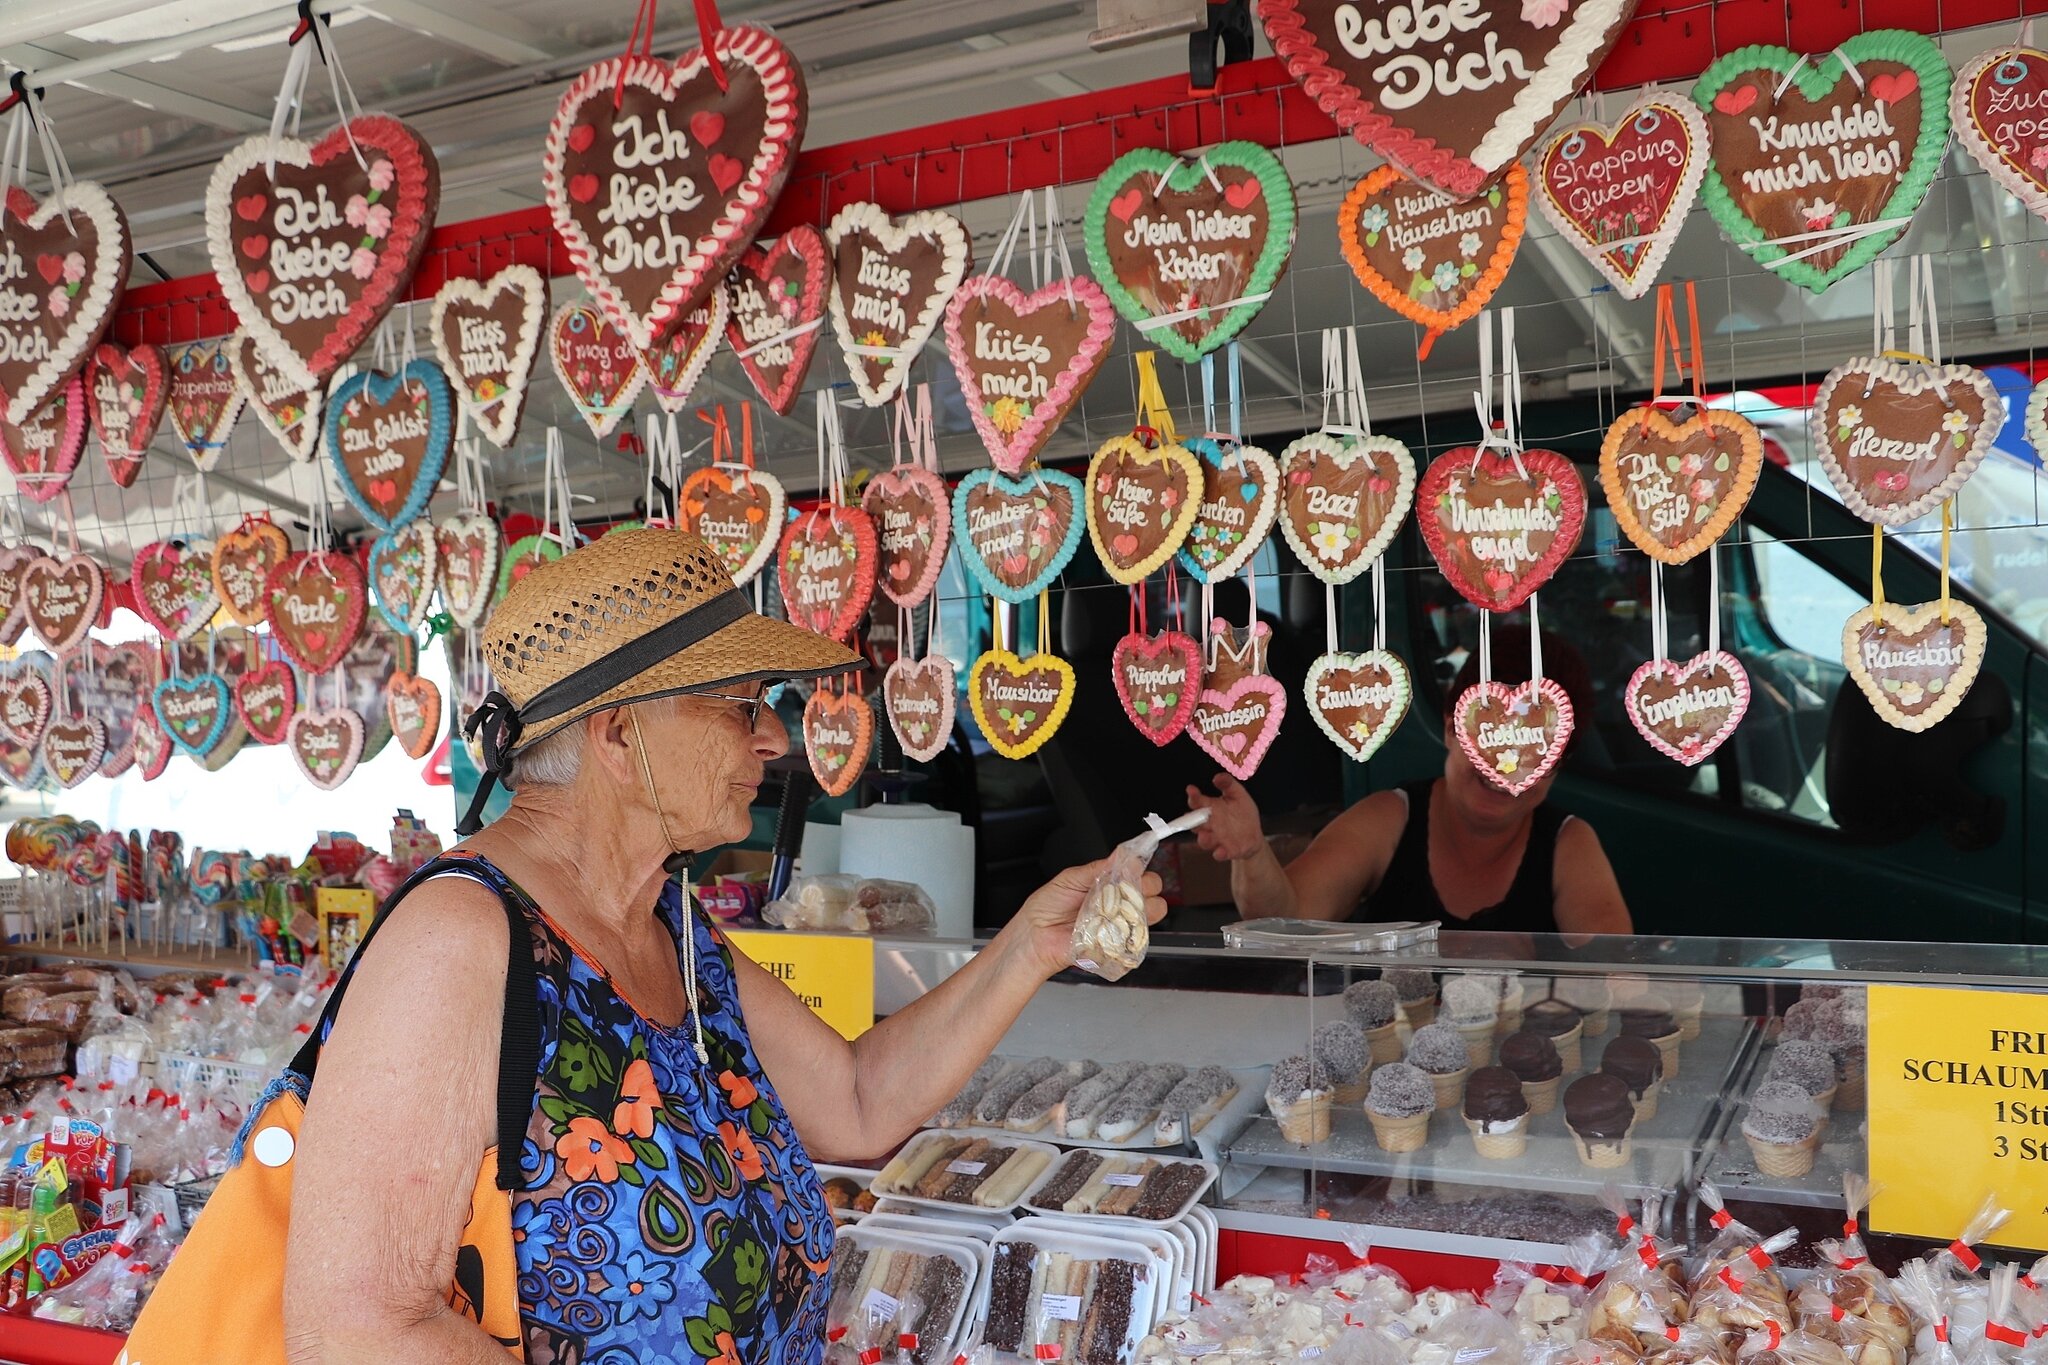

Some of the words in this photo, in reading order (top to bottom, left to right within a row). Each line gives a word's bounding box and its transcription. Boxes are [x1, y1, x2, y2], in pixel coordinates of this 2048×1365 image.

[1334, 0, 1492, 60] liebe
[1372, 31, 1535, 110] Dich
[612, 108, 691, 169] Ich
[1749, 99, 1896, 152] Knuddel
[1552, 136, 1684, 189] Shopping
[1742, 153, 1831, 194] mich
[274, 184, 344, 237] Ich
[1568, 170, 1668, 213] Queen
[602, 214, 692, 273] Dich
[1124, 213, 1188, 249] Mein
[1186, 209, 1257, 243] lieber
[269, 279, 350, 325] Dich
[852, 290, 906, 335] mich
[459, 345, 514, 378] mich
[981, 361, 1049, 399] mich
[342, 427, 374, 452] Du
[1849, 425, 1941, 461] Herzerl
[1618, 453, 1664, 482] Du
[1306, 486, 1360, 519] Bazi
[1632, 472, 1676, 511] bist
[800, 541, 843, 574] Mein
[980, 529, 1025, 559] maus
[1471, 530, 1538, 572] engel
[796, 575, 841, 605] Prinz
[284, 594, 340, 626] Perle
[986, 676, 1059, 703] Mausibär
[1127, 664, 1187, 692] Püppchen
[1195, 699, 1266, 735] Prinzessin
[1641, 686, 1735, 728] Engelchen
[1478, 720, 1547, 755] Liebling
[1903, 1058, 2048, 1091] SCHAUM
[1993, 1135, 2009, 1158] 3
